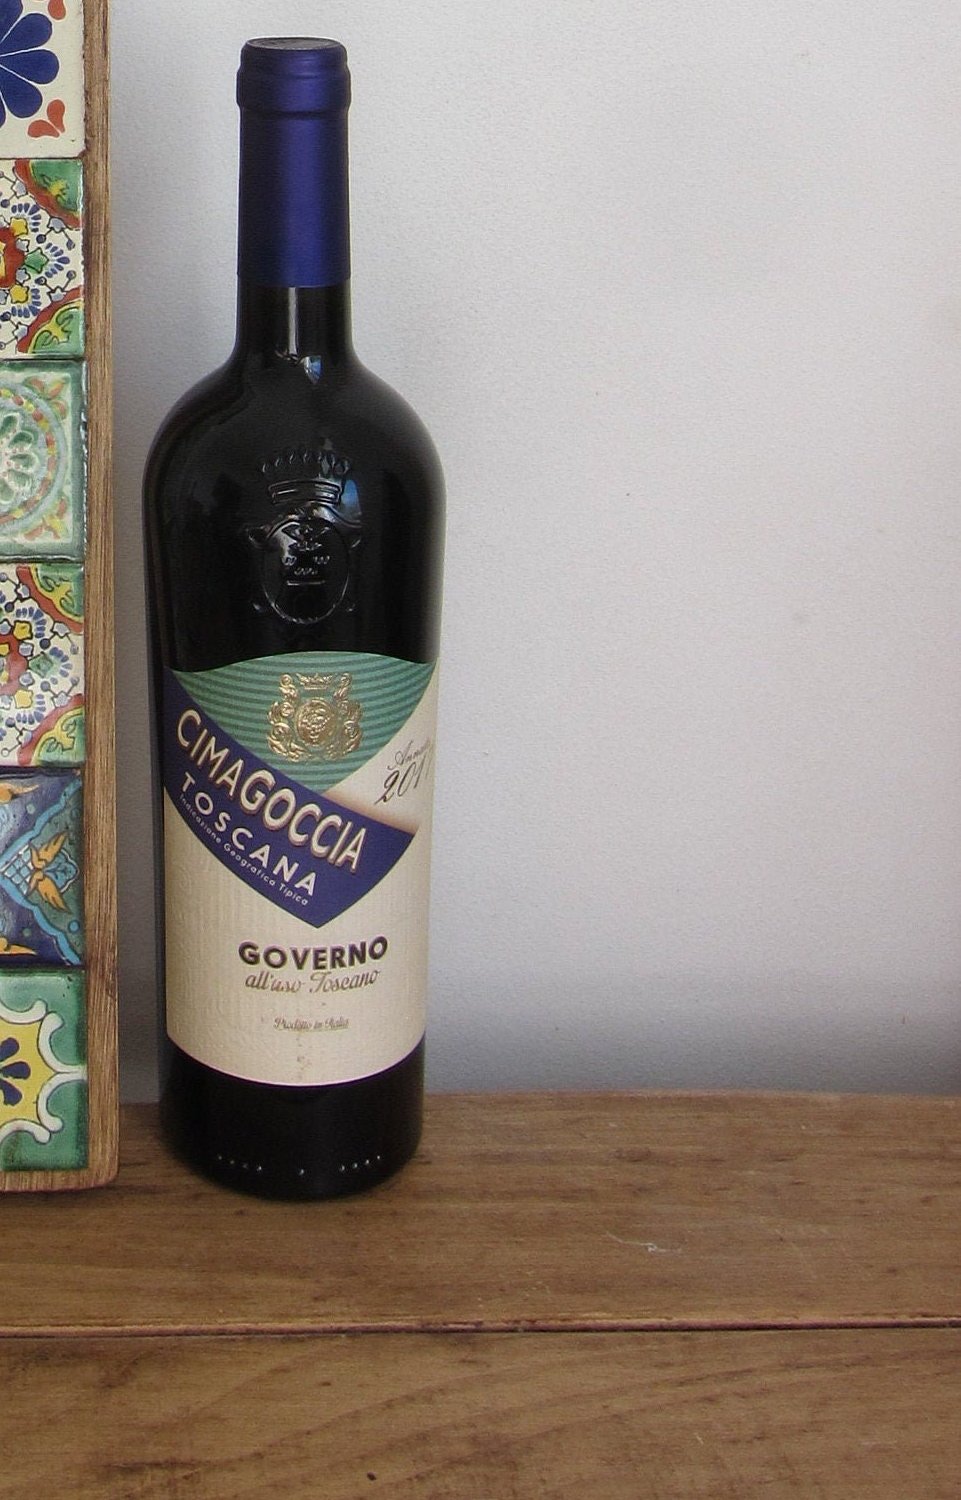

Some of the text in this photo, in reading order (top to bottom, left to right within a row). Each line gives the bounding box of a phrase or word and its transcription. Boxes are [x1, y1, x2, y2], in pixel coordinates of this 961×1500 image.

[177, 709, 367, 874] CIMAGOCCIA
[179, 771, 318, 896] TOSCANA
[278, 882, 309, 906] Tipica
[237, 934, 389, 970] GOVERNO
[308, 969, 381, 993] Toscano
